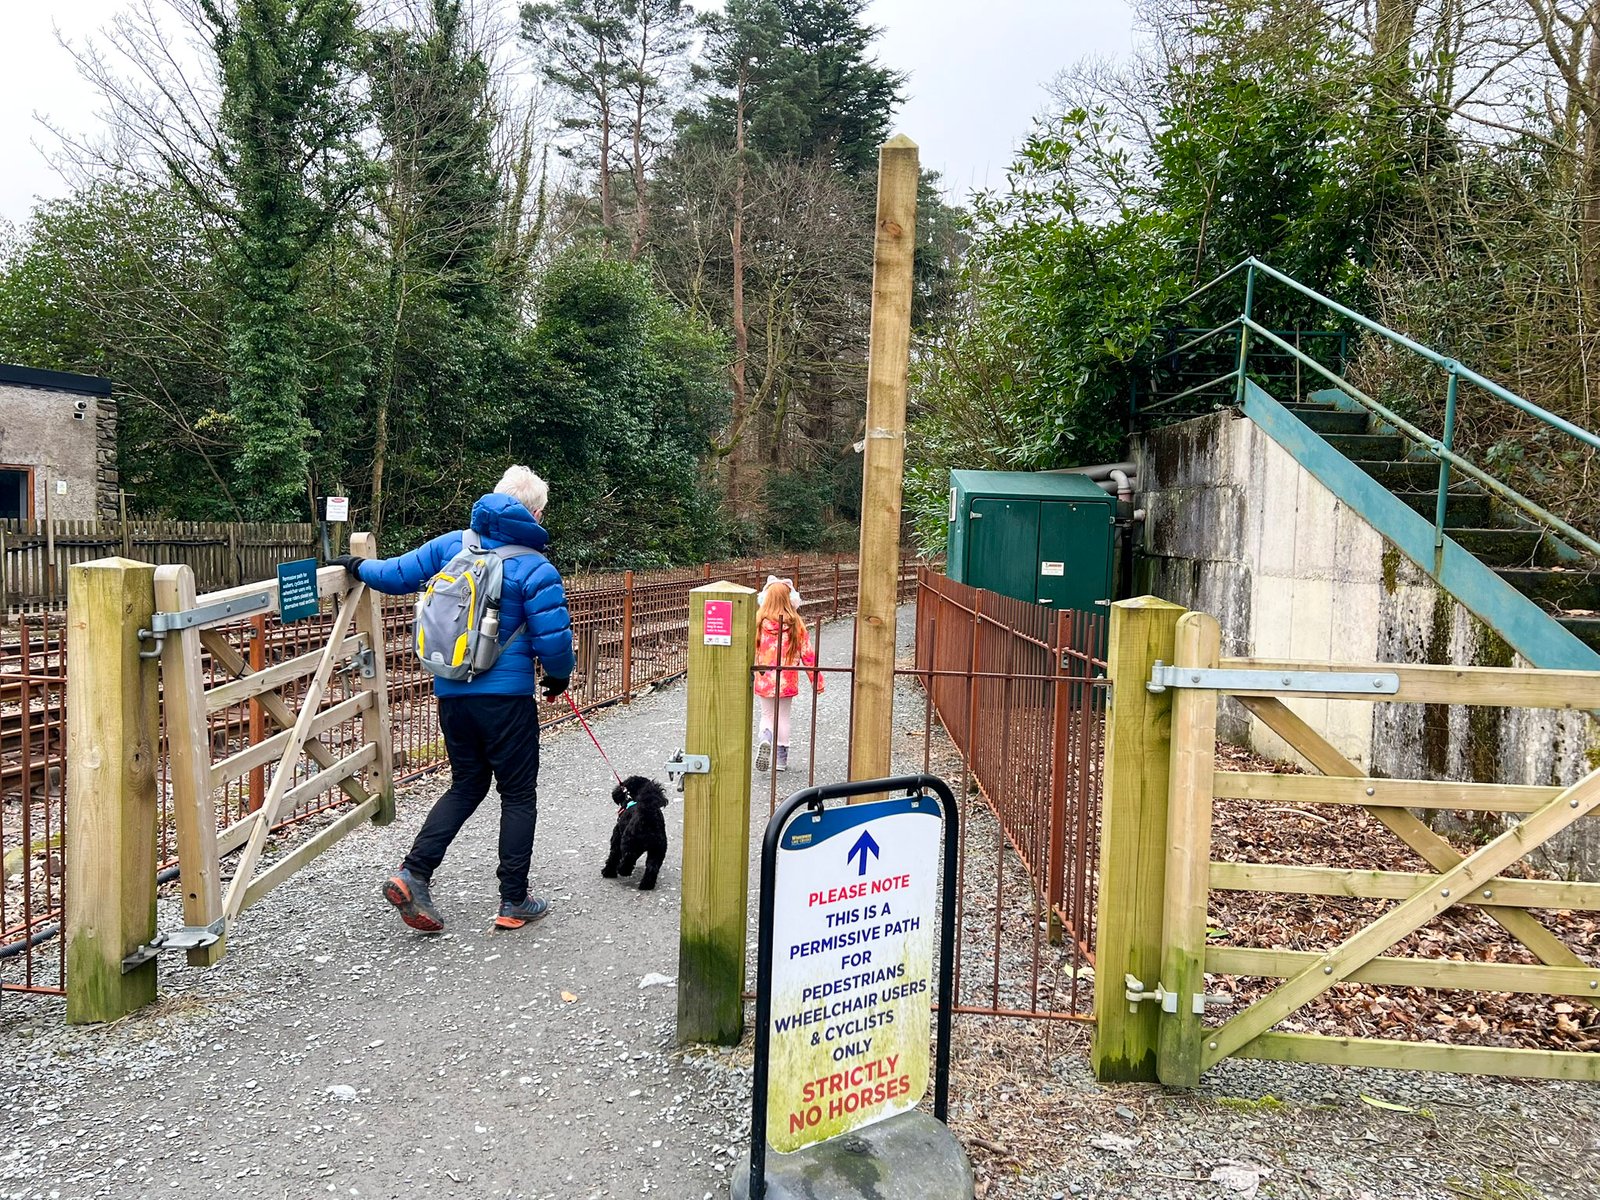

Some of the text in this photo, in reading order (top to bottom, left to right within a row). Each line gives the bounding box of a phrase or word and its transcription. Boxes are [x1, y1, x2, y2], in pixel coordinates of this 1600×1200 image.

[808, 874, 911, 908] PLEASE NOTE
[825, 902, 892, 929] THIS IS A
[789, 917, 921, 960] PERMISSIVE PATH
[841, 950, 872, 970] FOR
[801, 963, 906, 1003] PEDESTRIANS
[774, 979, 927, 1034] WHEELCHAIR USERS
[810, 1010, 895, 1047] & CYCLISTS
[832, 1037, 873, 1062] ONLY
[802, 1054, 900, 1104] STRICTLY
[789, 1075, 911, 1135] NO HORSES
